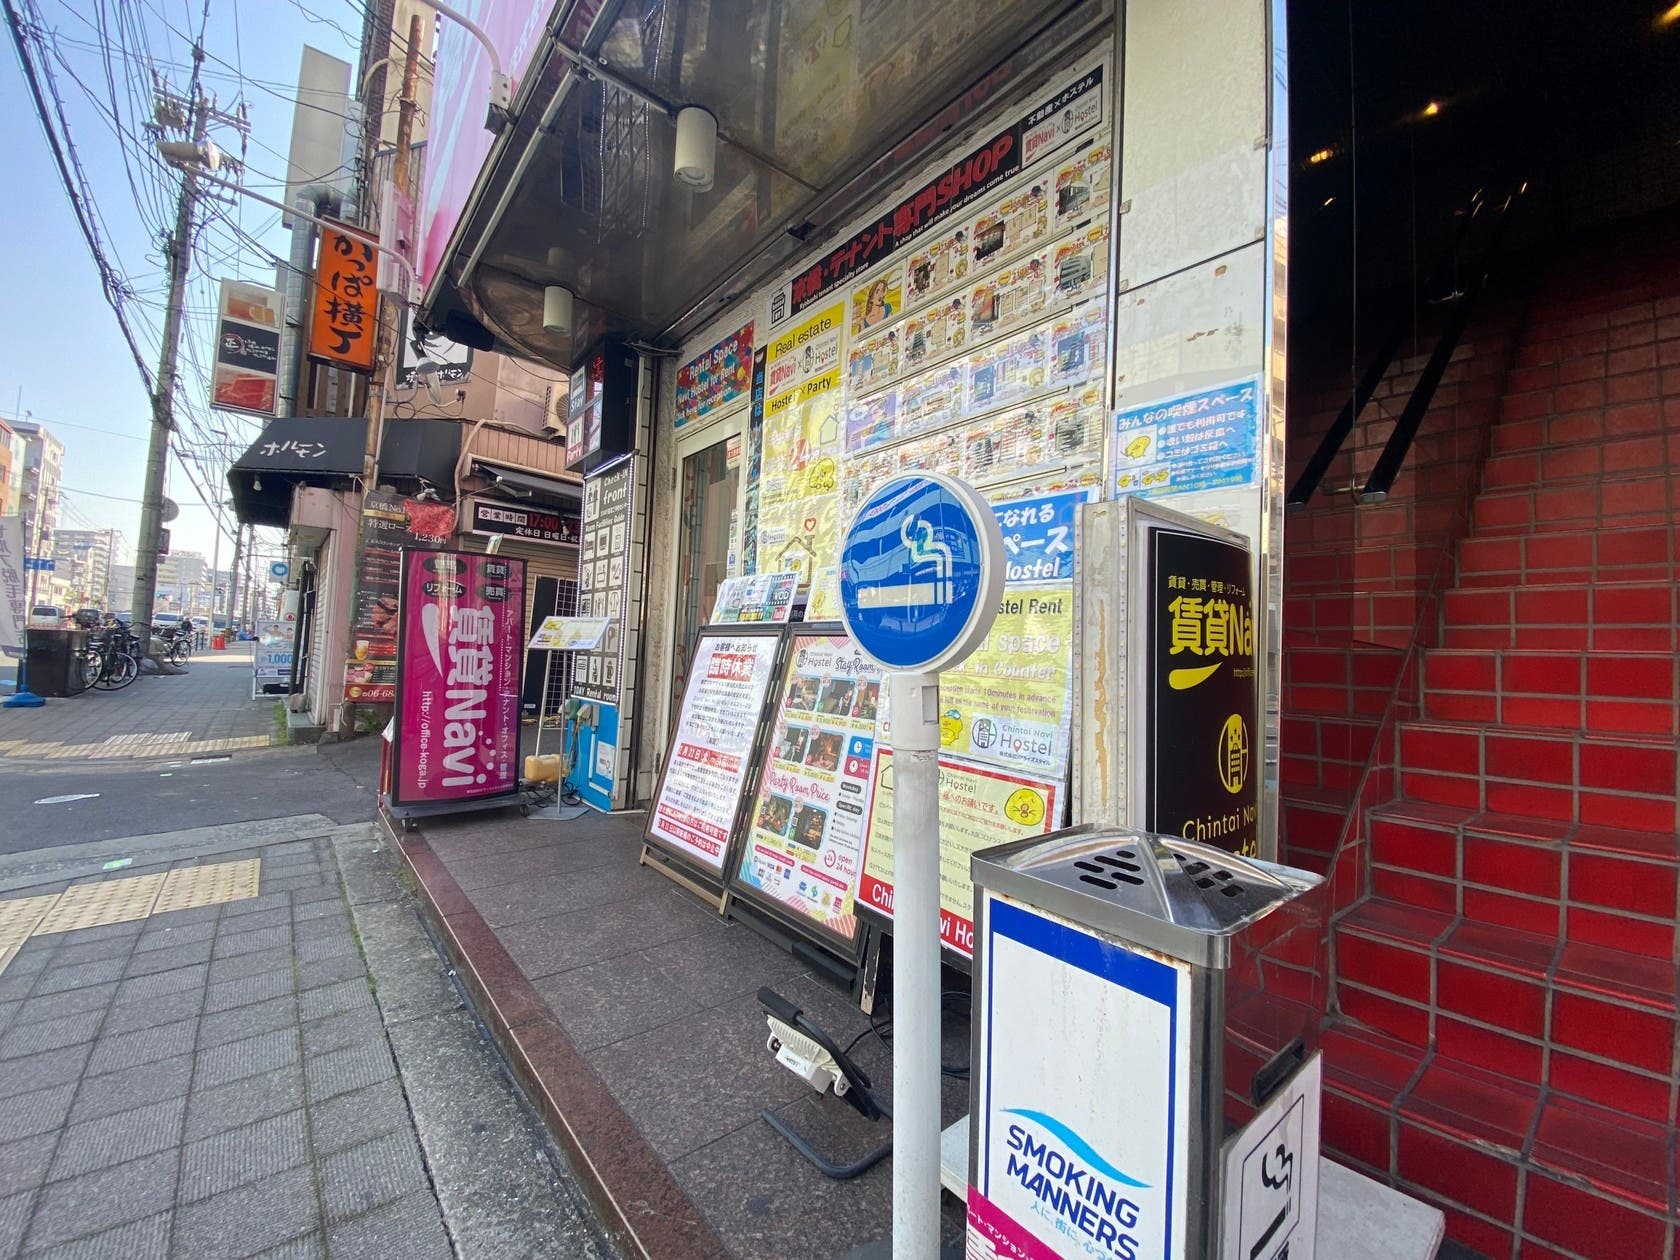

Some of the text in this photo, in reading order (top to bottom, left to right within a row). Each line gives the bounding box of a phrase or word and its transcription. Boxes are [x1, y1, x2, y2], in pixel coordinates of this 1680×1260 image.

[934, 210, 951, 222] make
[950, 200, 964, 214] your
[963, 186, 986, 203] dreams
[986, 174, 1004, 190] come
[1004, 165, 1020, 178] true
[324, 234, 374, 354] かっぱ横丁
[775, 318, 832, 358] Real estate
[689, 340, 738, 380] Rental Space
[807, 377, 832, 395] Party
[260, 440, 326, 458] ホルモン
[602, 482, 628, 505] front
[478, 507, 527, 526] 営業時間
[515, 526, 541, 537] 定休日
[426, 582, 463, 595] リフォーム
[1168, 575, 1246, 597] 賃貸・売買・管理・リフォーム
[998, 598, 1063, 614] stel Rent
[997, 634, 1061, 655] space
[835, 657, 854, 674] Stay
[993, 661, 1057, 680] Counter
[367, 689, 395, 698] 06-68
[442, 605, 495, 787] 賃貸Navi
[1027, 693, 1057, 704] advance
[1000, 734, 1053, 756] Hostel
[788, 776, 810, 796] Room
[810, 783, 831, 801] Price
[946, 780, 977, 794] Hostel
[1182, 807, 1240, 842] Chintai
[872, 883, 894, 910] Chi
[1007, 1124, 1141, 1229] SMOKING
[1006, 1153, 1141, 1260] MANNERS
